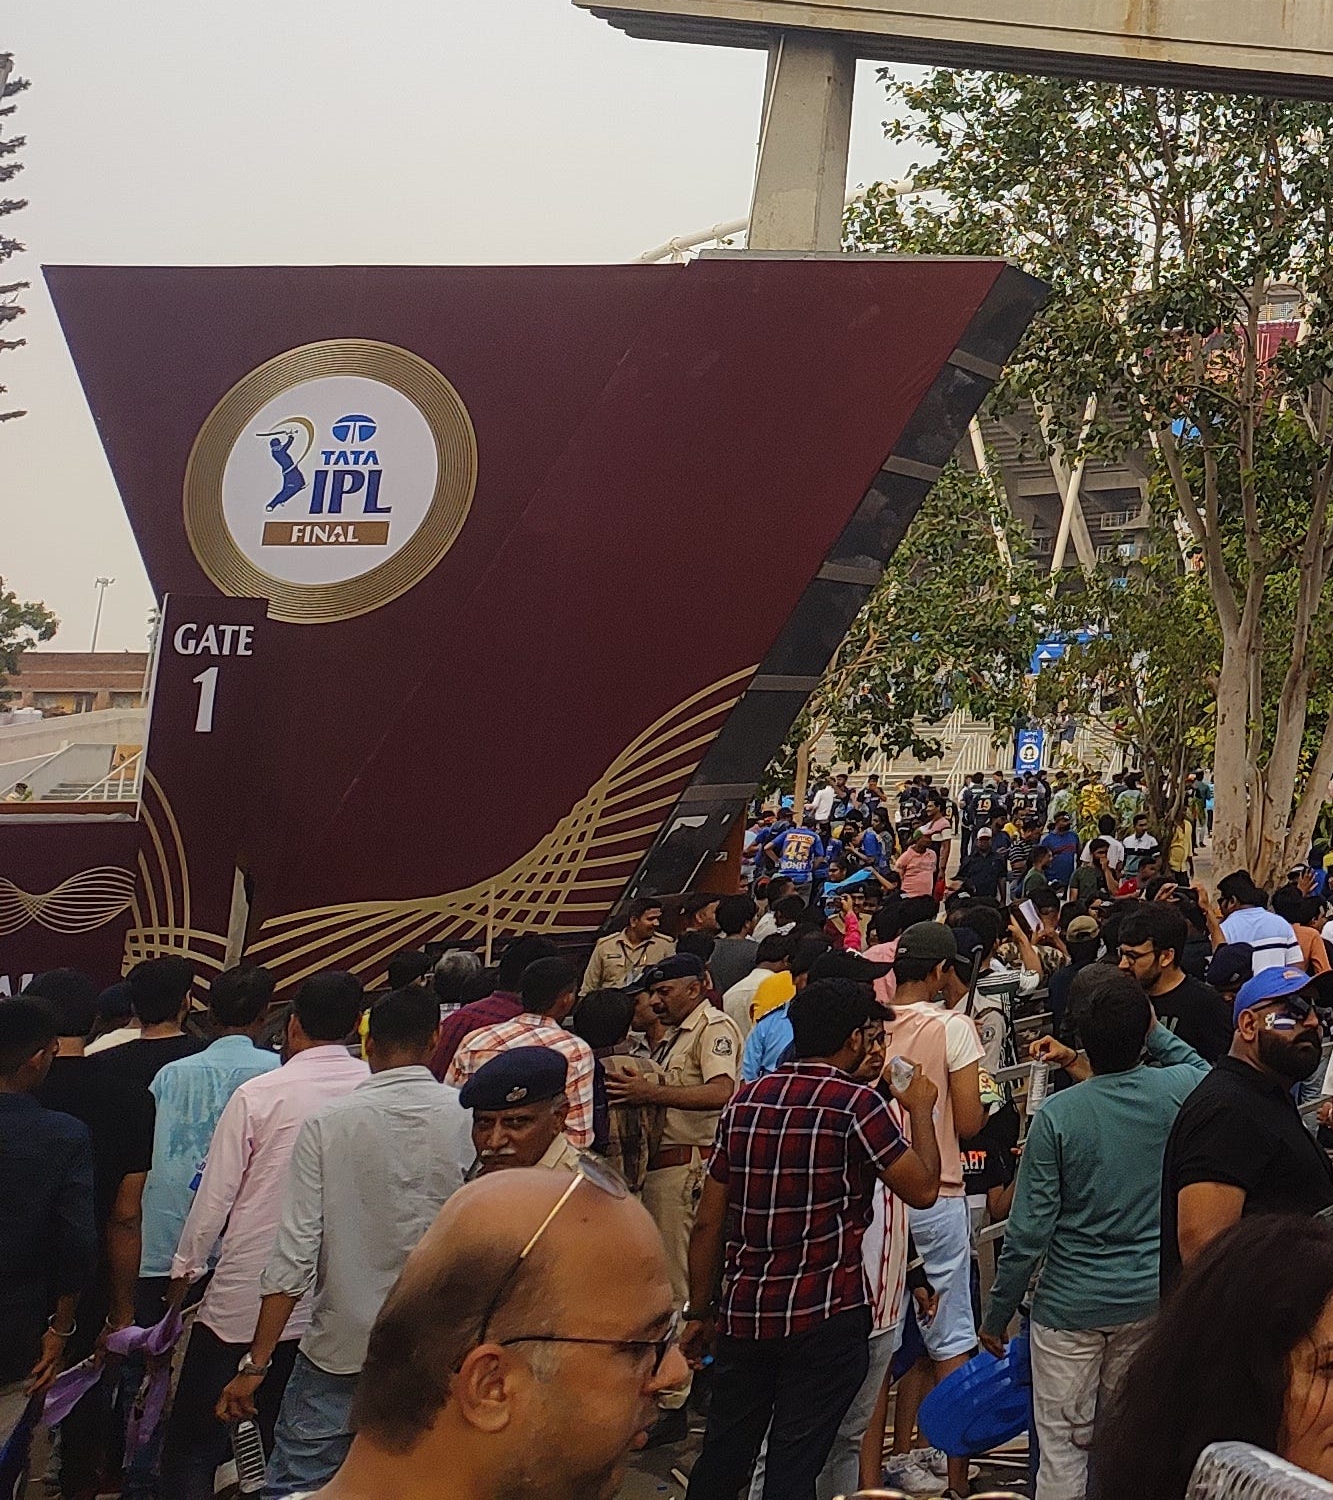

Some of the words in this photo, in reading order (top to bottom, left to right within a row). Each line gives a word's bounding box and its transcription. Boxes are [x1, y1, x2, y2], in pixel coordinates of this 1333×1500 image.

[320, 449, 379, 466] TATA
[309, 469, 392, 514] IPL
[289, 524, 360, 544] FINAL
[173, 623, 256, 657] GATE
[192, 665, 220, 733] 1
